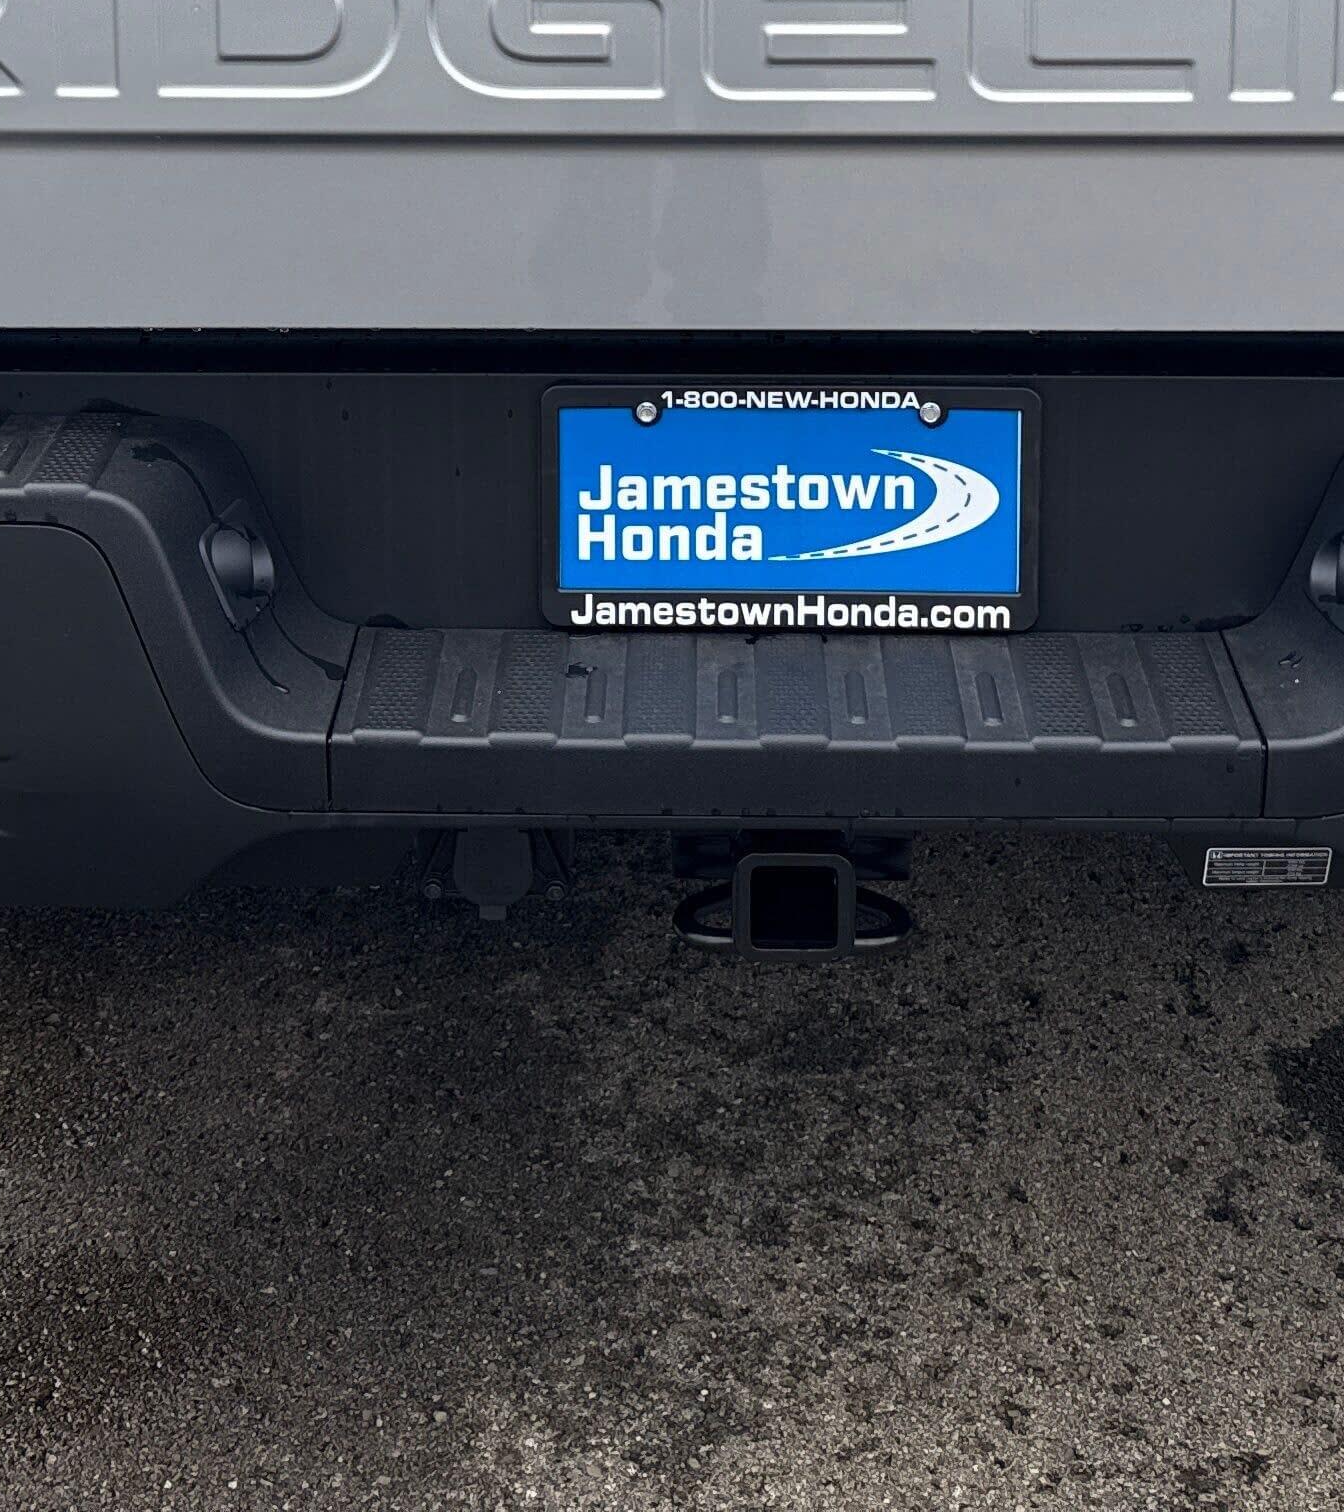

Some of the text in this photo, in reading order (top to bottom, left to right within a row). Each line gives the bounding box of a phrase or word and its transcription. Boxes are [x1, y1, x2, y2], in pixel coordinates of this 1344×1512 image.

[660, 390, 920, 410] 1-800-NEW-HONDA
[578, 464, 916, 511] Jamestown
[577, 511, 764, 562] Honda
[570, 593, 1011, 629] JamestownHonda.com
